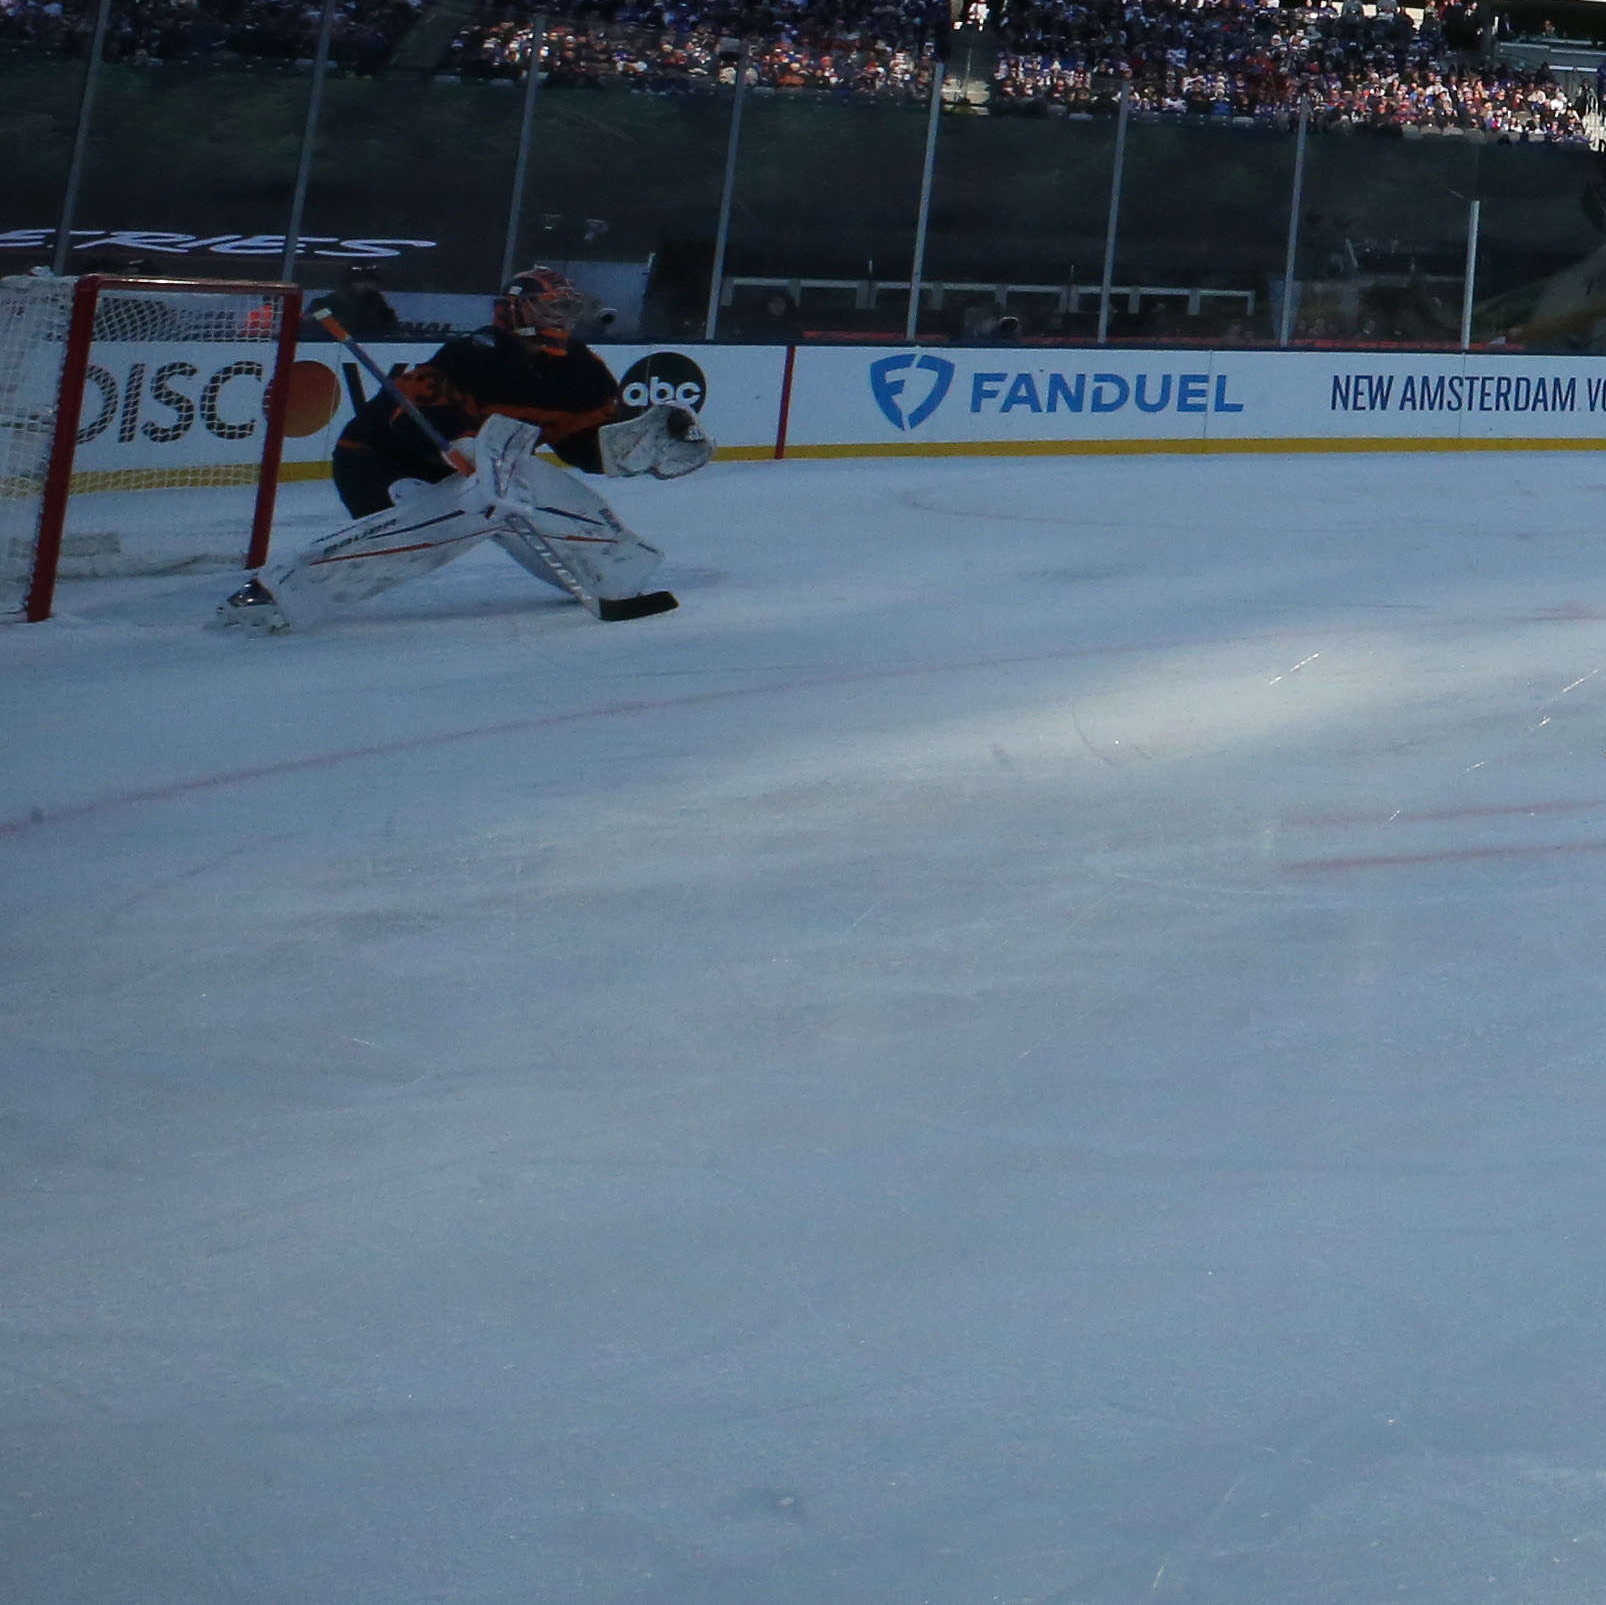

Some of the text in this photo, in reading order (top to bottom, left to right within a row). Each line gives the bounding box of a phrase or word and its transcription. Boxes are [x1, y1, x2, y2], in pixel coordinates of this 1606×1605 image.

[623, 374, 702, 408] abc
[969, 372, 1244, 413] FANDUEL
[1330, 374, 1394, 411] NEW
[1399, 375, 1576, 412] AMSTERDAM
